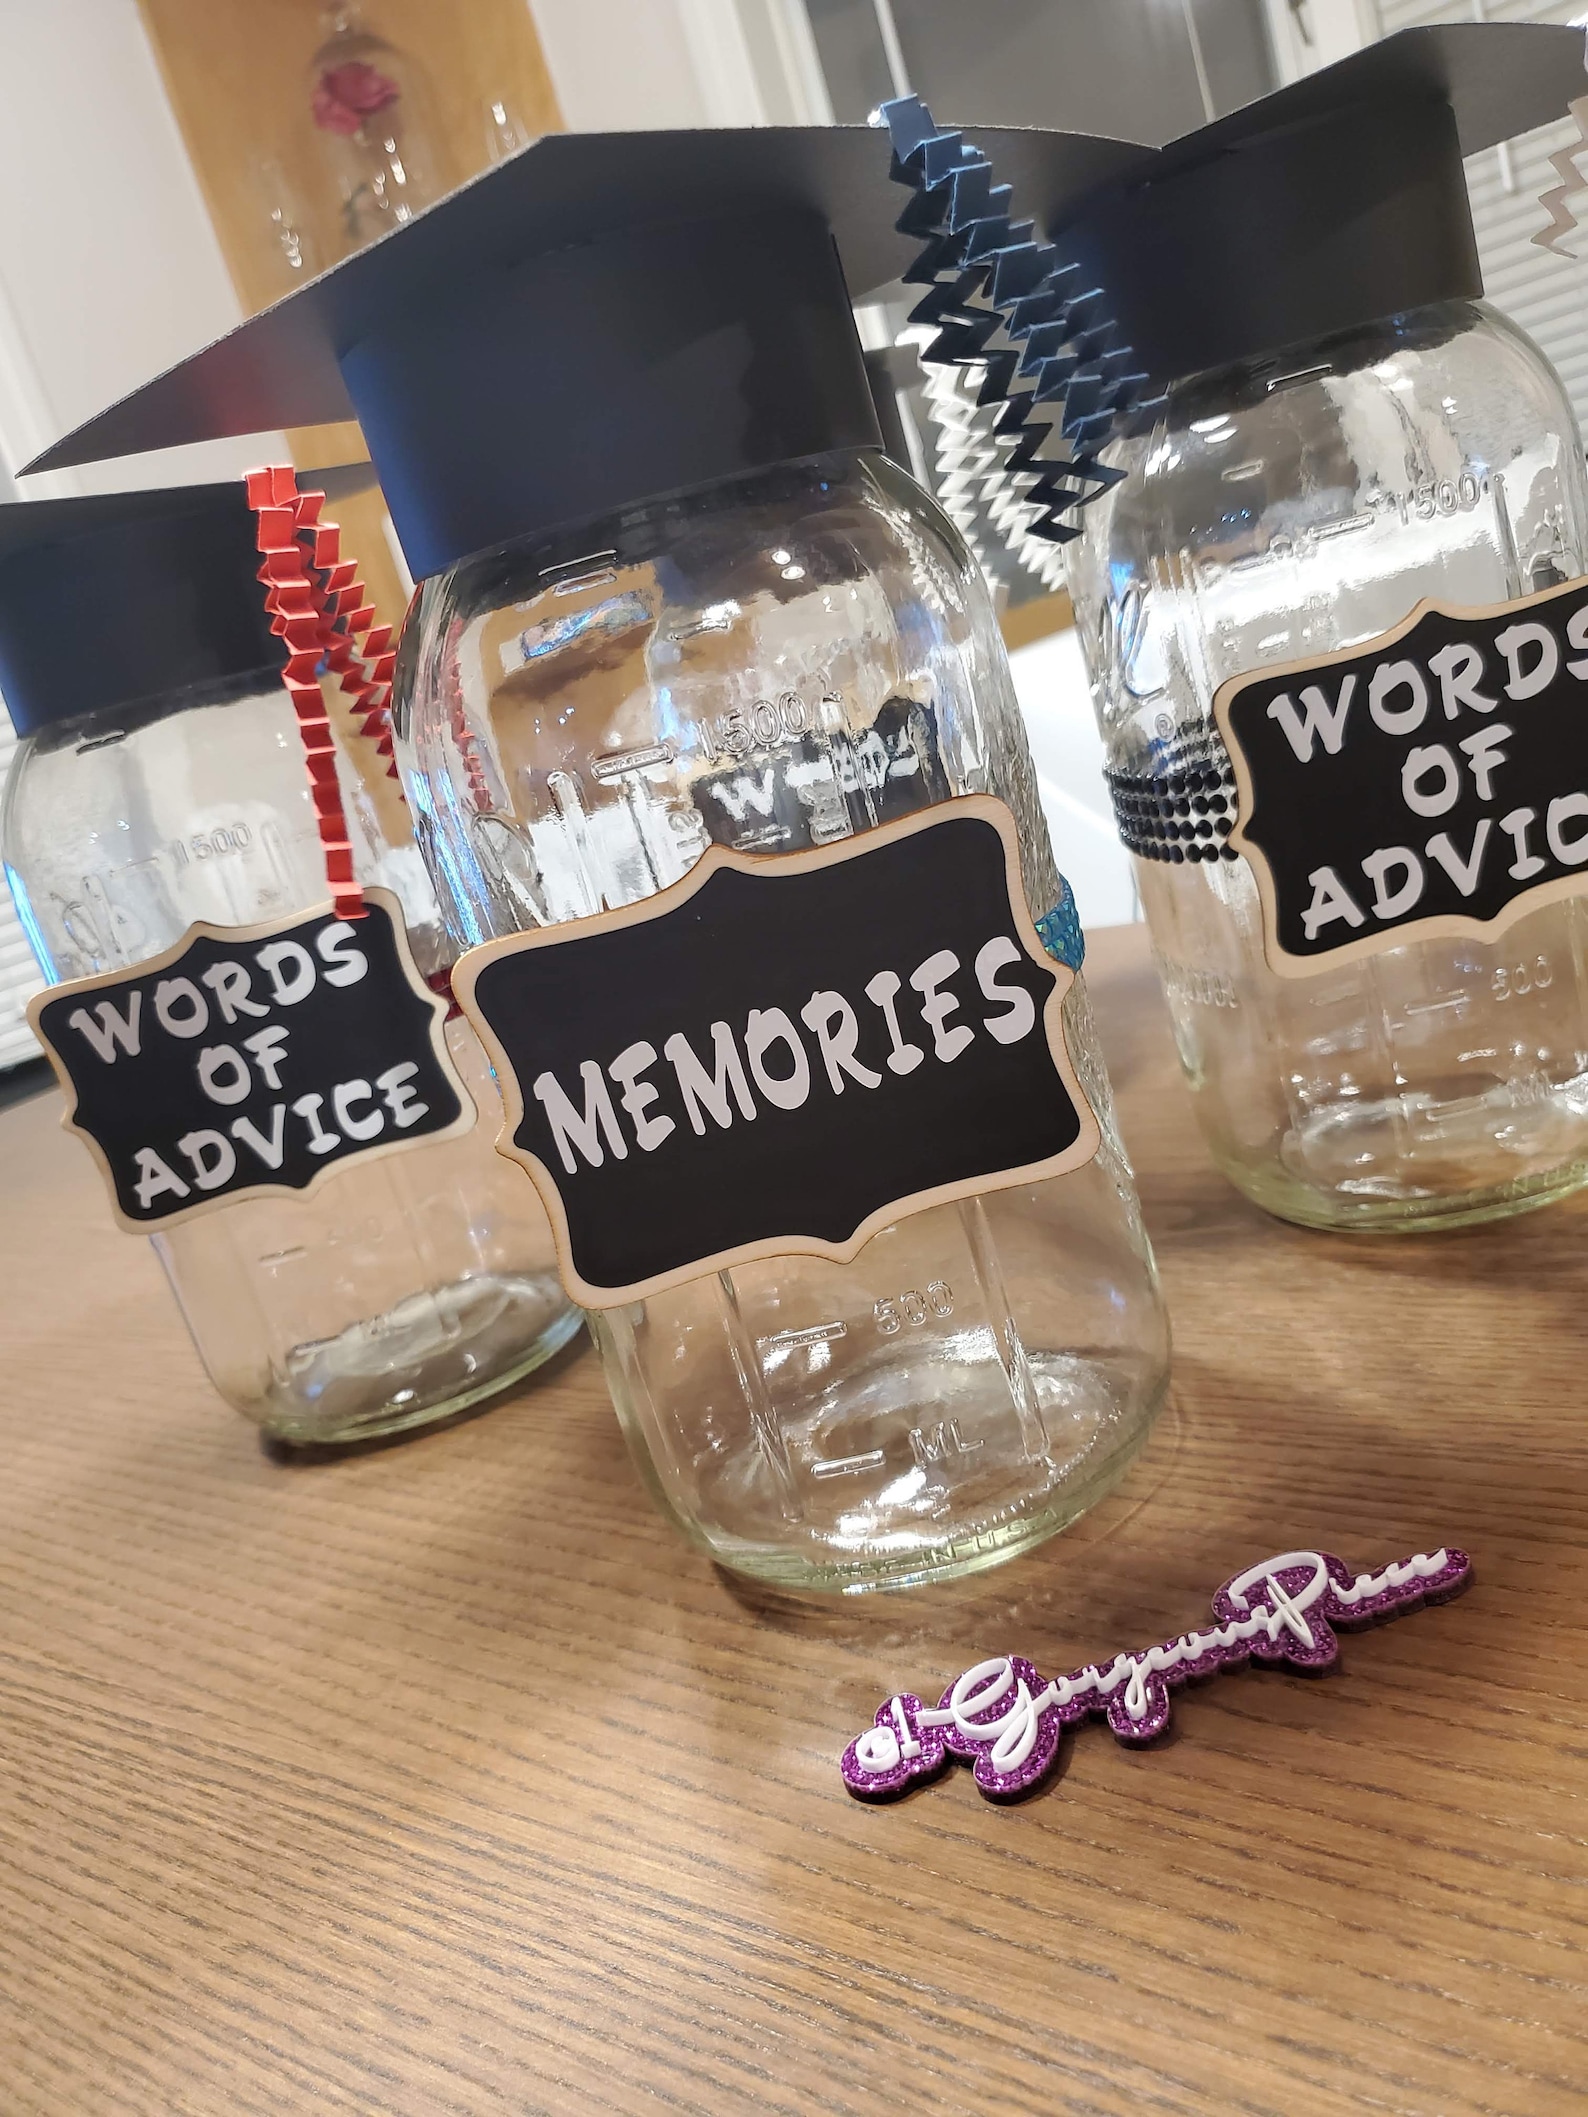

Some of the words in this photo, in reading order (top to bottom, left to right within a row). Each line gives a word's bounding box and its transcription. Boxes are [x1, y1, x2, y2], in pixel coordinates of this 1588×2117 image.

[1397, 472, 1482, 525] 1500
[698, 692, 807, 762] 1500
[1401, 724, 1512, 817] OF
[174, 823, 253, 866] 1500
[70, 922, 369, 1064] WORDS
[197, 1026, 290, 1105] OF
[532, 936, 1036, 1173] MEMORIES
[134, 1062, 430, 1208] ADVICE
[872, 1280, 955, 1334] 500
[908, 1417, 985, 1467] ML
